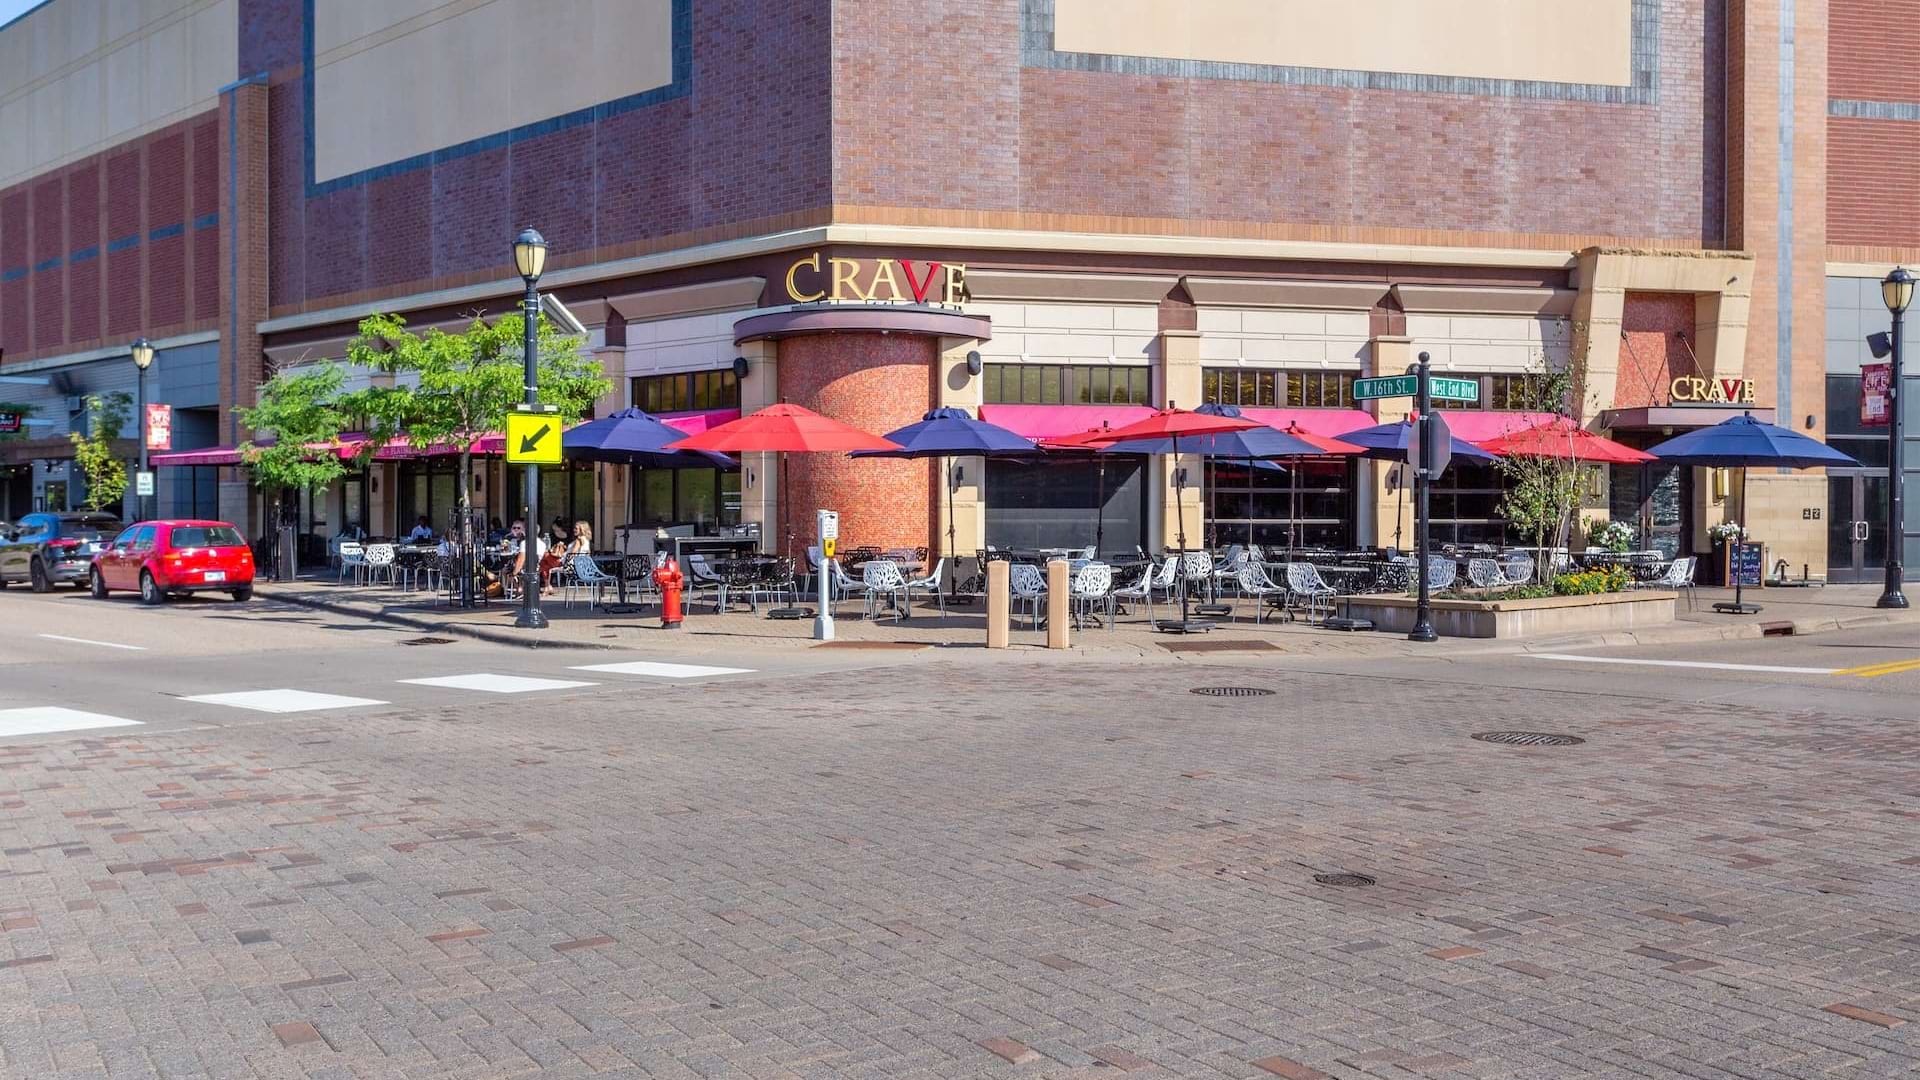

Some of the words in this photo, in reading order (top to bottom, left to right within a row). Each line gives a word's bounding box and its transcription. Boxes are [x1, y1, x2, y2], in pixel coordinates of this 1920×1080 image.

[785, 252, 967, 306] CRAVE
[1396, 378, 1409, 394] St.
[1431, 380, 1446, 396] West
[1449, 381, 1460, 397] End
[1671, 375, 1756, 403] CRAVE
